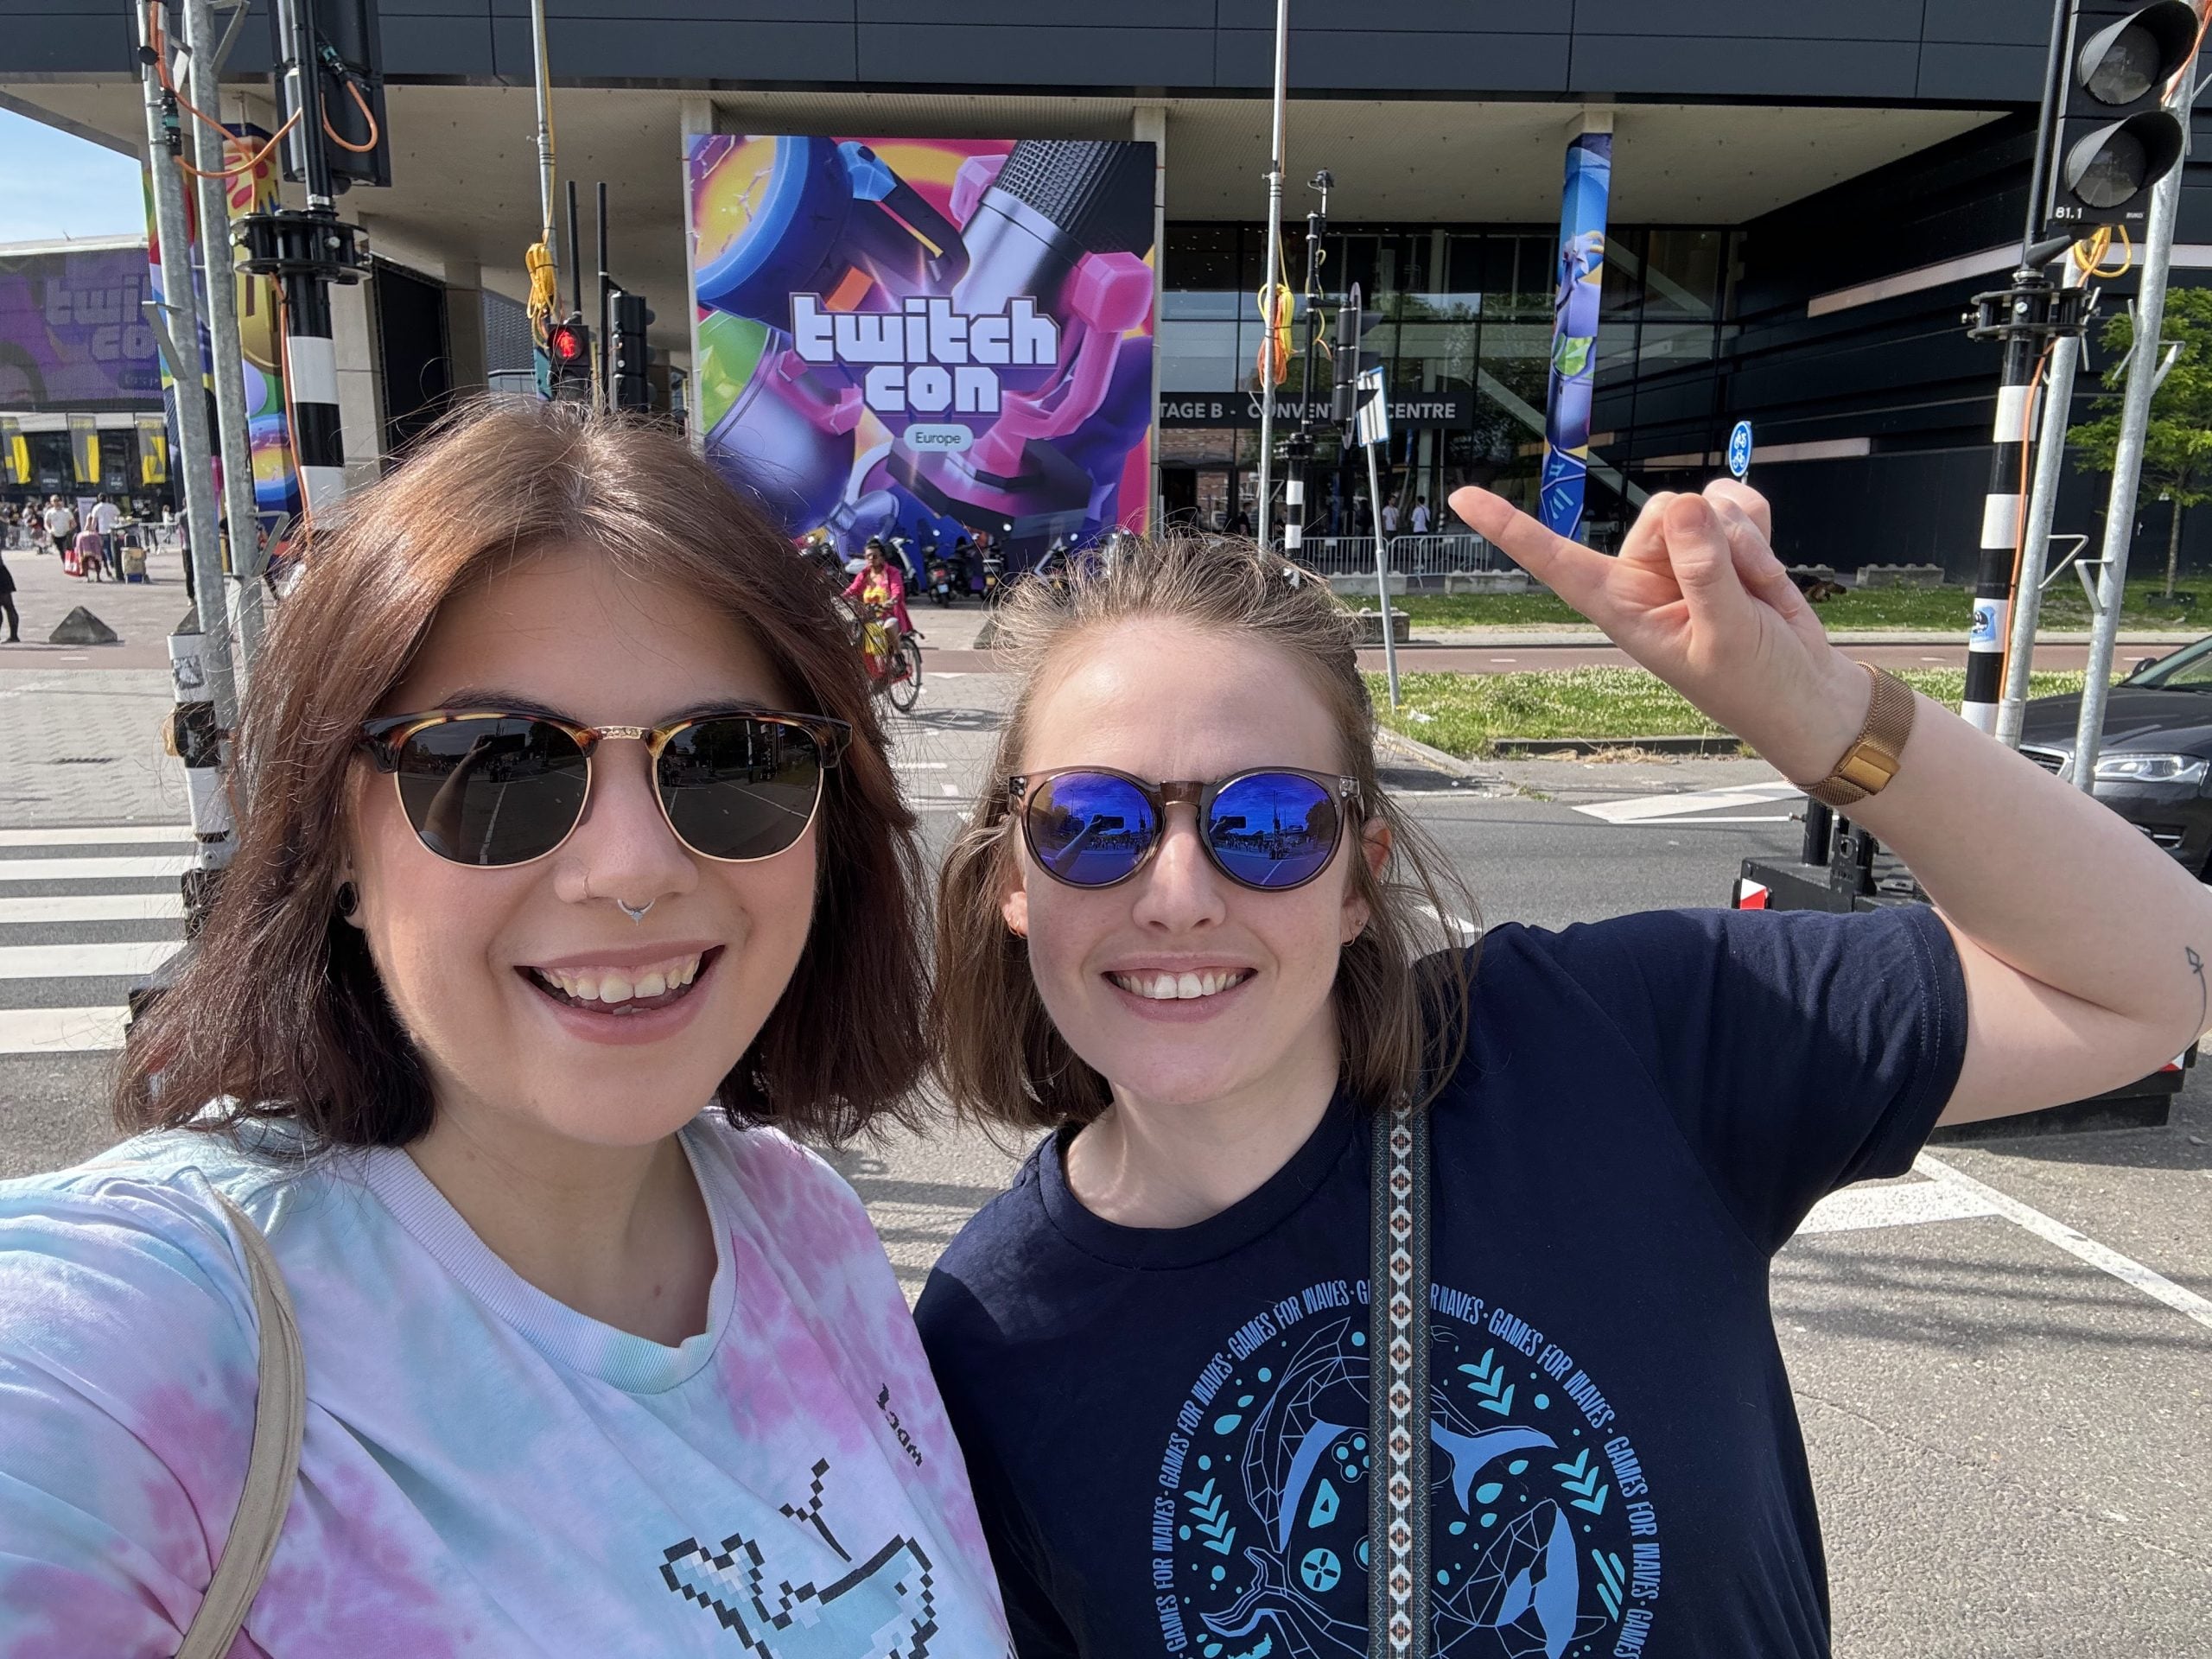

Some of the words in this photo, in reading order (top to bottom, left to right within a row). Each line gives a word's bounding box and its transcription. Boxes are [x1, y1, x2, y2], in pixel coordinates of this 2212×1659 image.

[2056, 207, 2082, 219] 81.1
[47, 276, 152, 325] twi
[92, 325, 156, 360] co
[793, 296, 1058, 364] twitch
[865, 365, 999, 412] con
[1160, 403, 1206, 418] TAGE
[1211, 403, 1224, 418] B
[915, 432, 962, 444] Europe
[1274, 1296, 1304, 1330] FOR
[1301, 1280, 1351, 1314] WAVES
[1227, 1312, 1277, 1362] GAMES
[1488, 1307, 1544, 1357] GAMES
[1191, 1352, 1234, 1407] WAVES
[1536, 1344, 1573, 1382] FOR
[1177, 1399, 1205, 1435] FOR
[1562, 1369, 1616, 1429] WAVES
[1159, 1432, 1190, 1490] GAMES
[1604, 1435, 1649, 1498] GAMES
[1152, 1497, 1175, 1552] WAVES
[1625, 1501, 1658, 1536] FOR
[1152, 1558, 1174, 1590] FOR
[1630, 1542, 1662, 1599] WAVES
[1155, 1594, 1188, 1652] GAMES
[1613, 1608, 1654, 1659] GAMES
